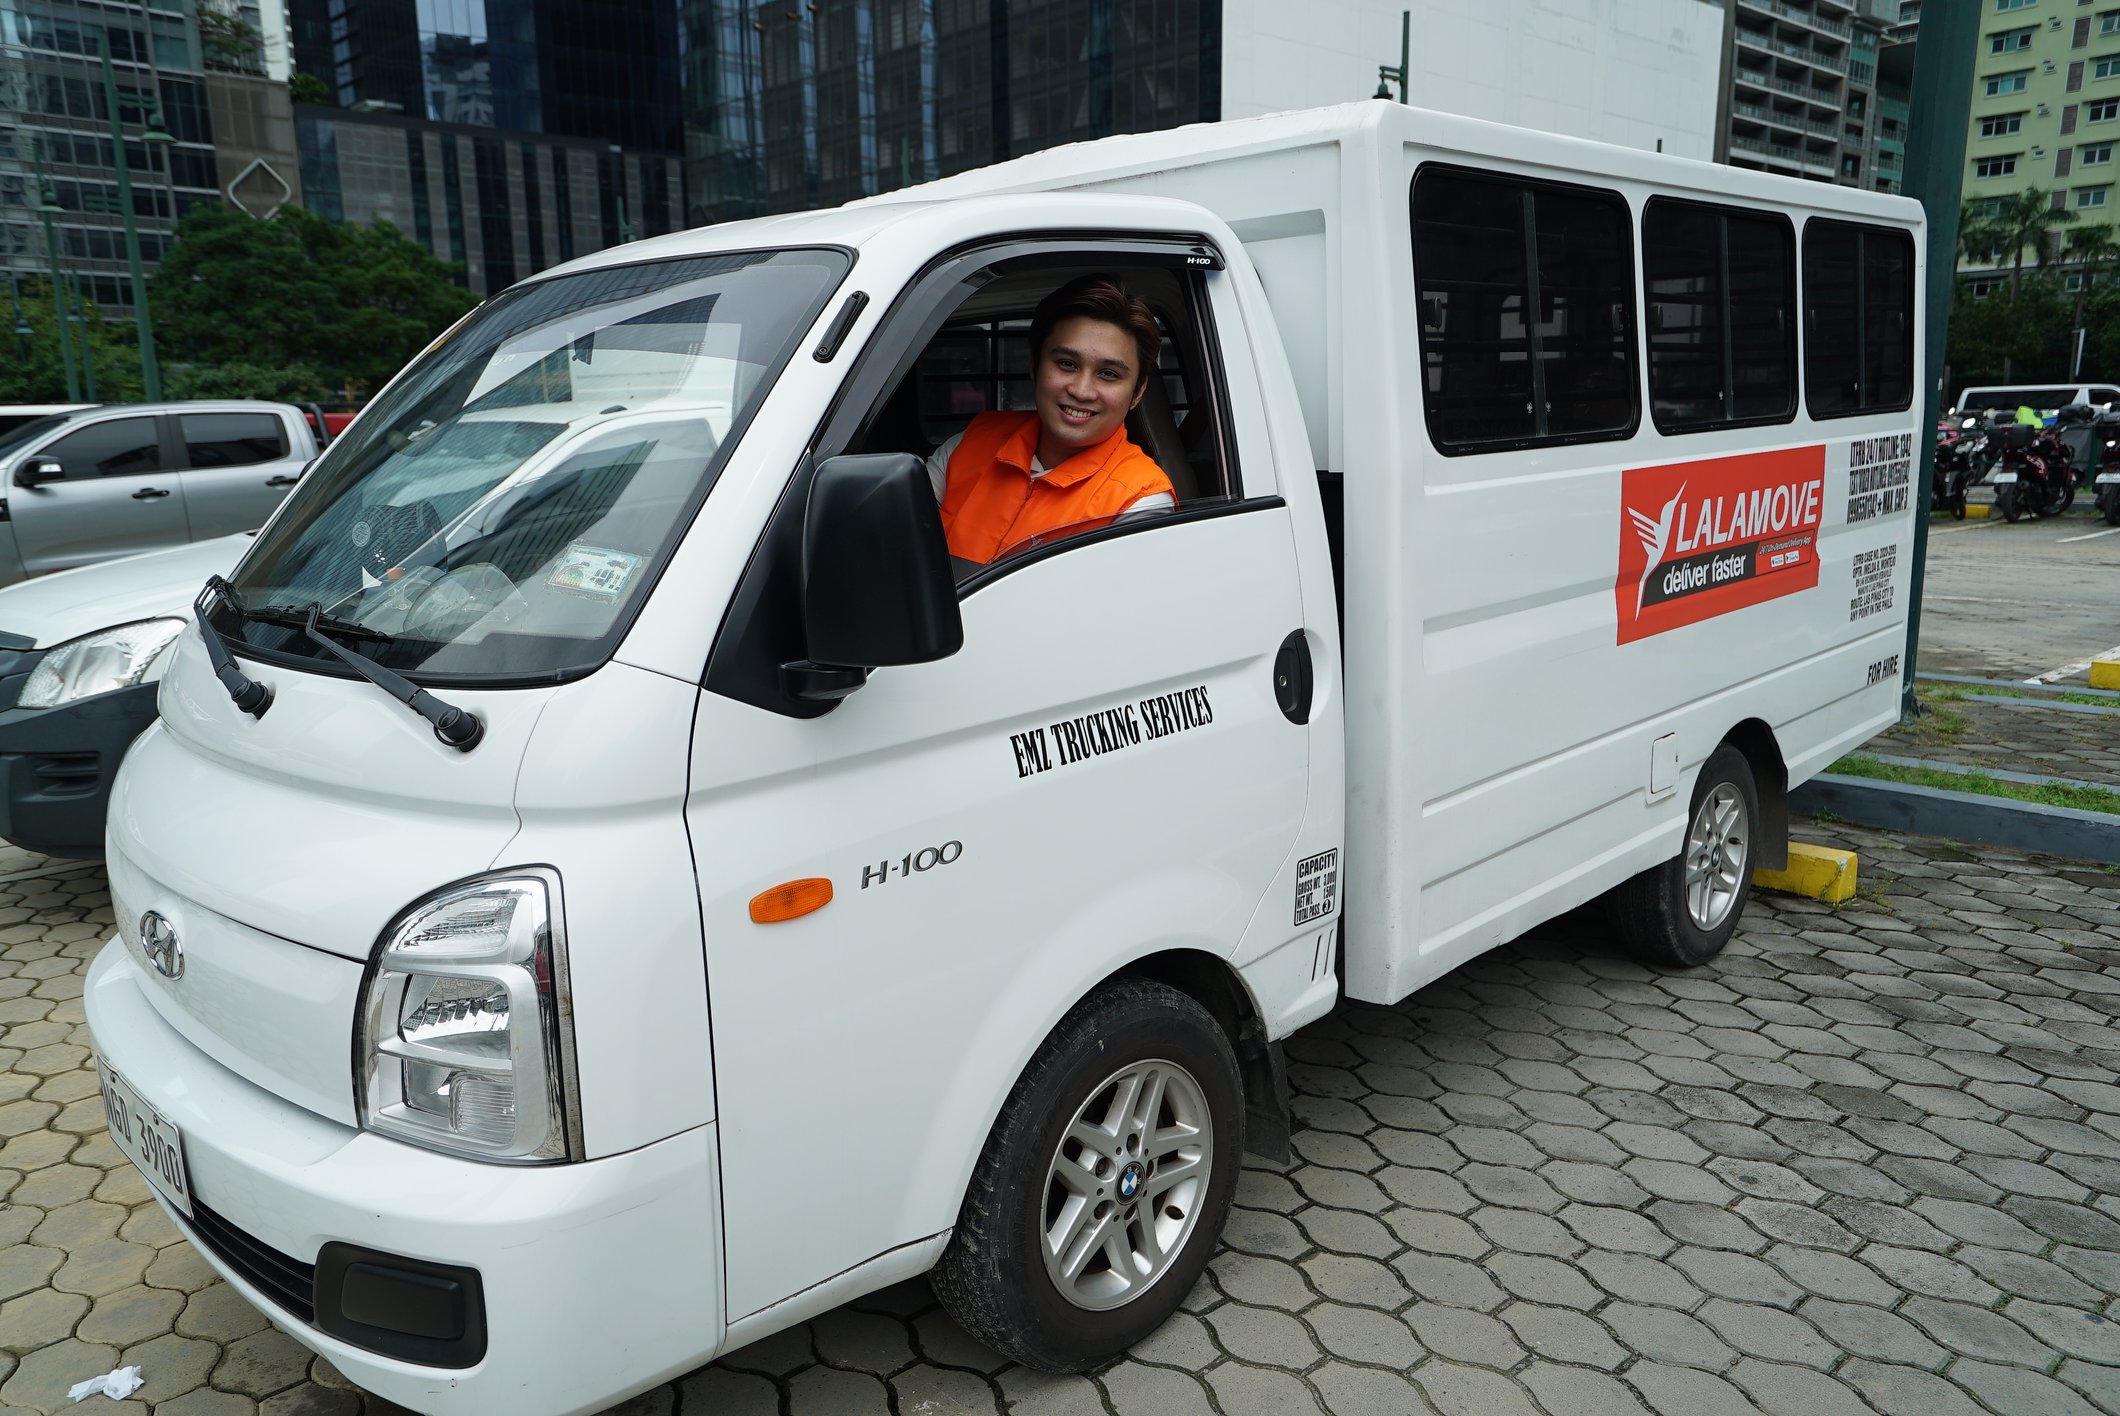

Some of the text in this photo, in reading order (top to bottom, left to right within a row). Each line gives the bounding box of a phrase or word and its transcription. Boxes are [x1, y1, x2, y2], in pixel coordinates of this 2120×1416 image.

[1676, 480, 1820, 552] LALAMOVE
[1664, 552, 1746, 596] deliver faster
[1867, 654, 1899, 686] FOR HIRE
[1010, 685, 1213, 778] EMZ TRUCKING SERVICES
[861, 840, 962, 890] H-100
[1300, 852, 1336, 878] CAPACITY
[136, 1113, 183, 1194] 3900
